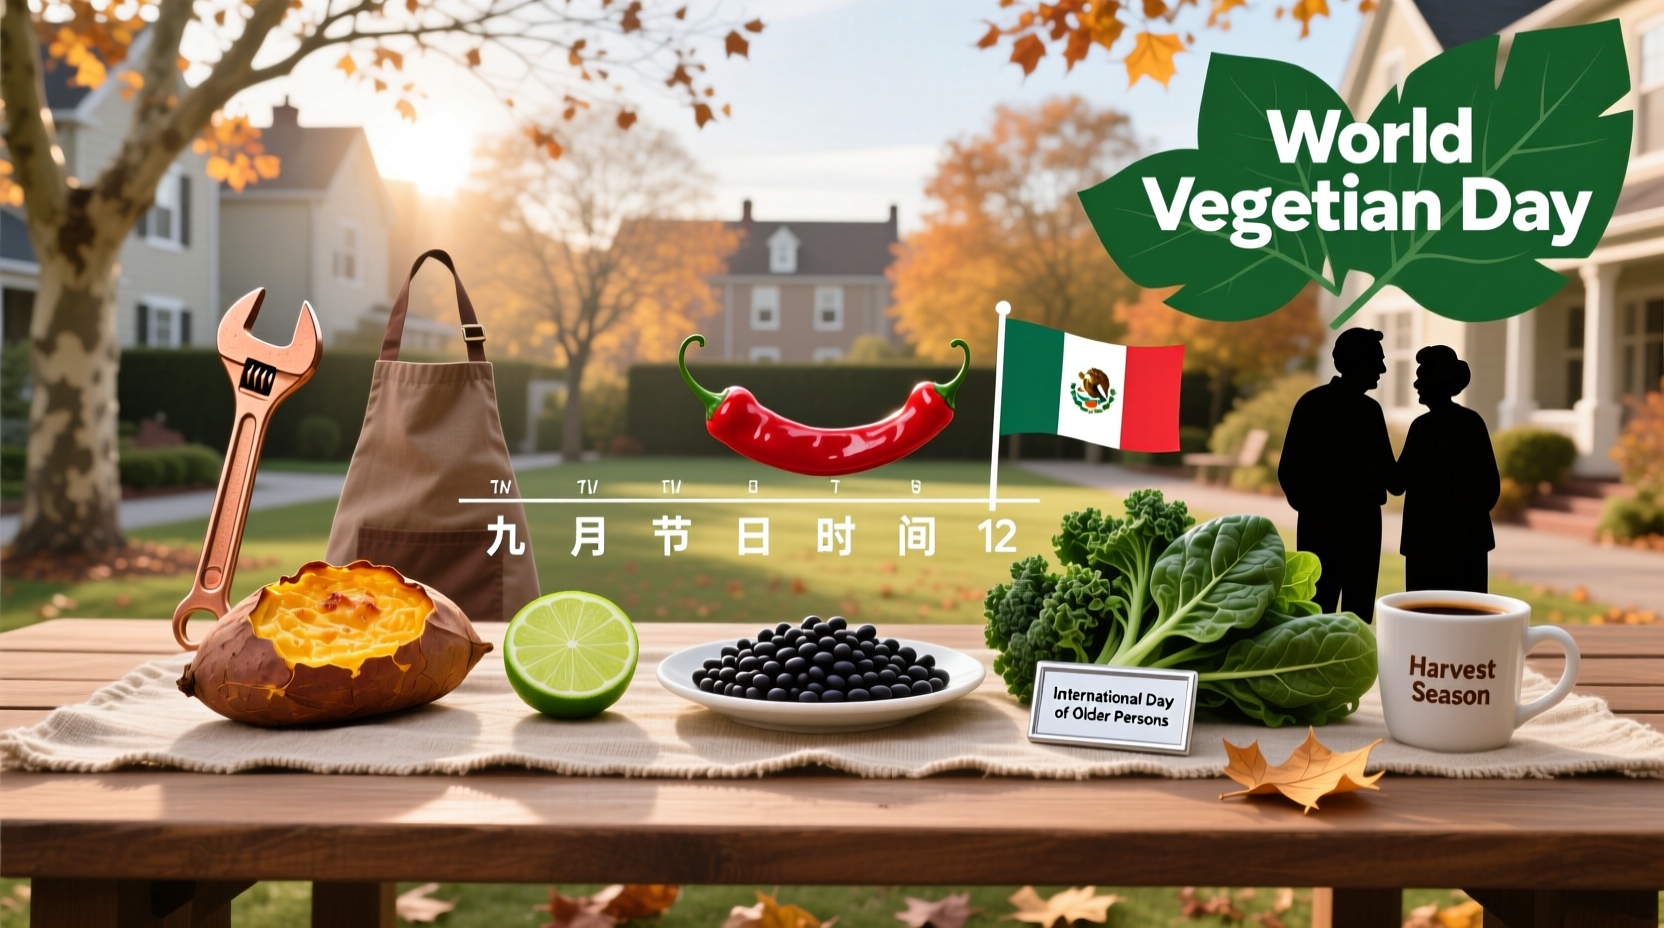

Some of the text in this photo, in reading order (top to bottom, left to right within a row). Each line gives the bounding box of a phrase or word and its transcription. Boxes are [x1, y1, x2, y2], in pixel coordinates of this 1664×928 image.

[1409, 654, 1497, 681] Harvest
[1053, 686, 1175, 711] International Day
[1411, 680, 1491, 706] Season
[1054, 706, 1169, 727] of Older Persons
